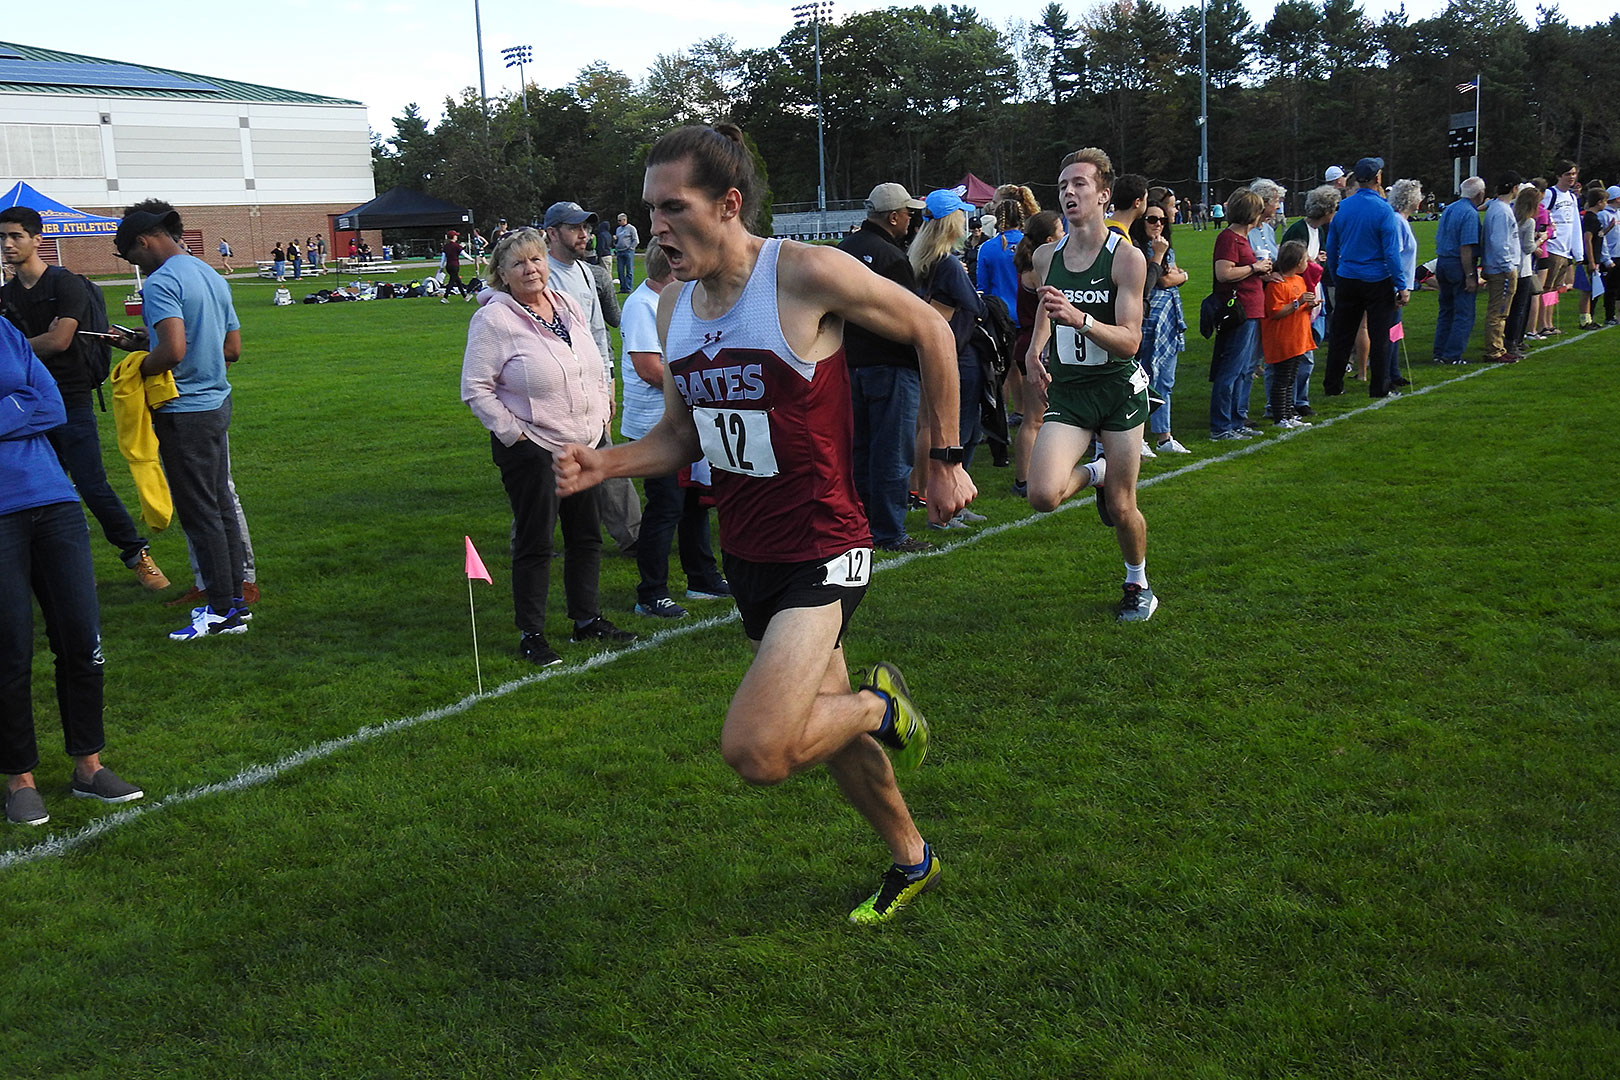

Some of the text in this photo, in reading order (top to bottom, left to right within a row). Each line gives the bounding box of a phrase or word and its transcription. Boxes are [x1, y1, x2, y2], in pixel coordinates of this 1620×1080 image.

[62, 221, 119, 233] ATHLETICS
[1060, 289, 1110, 304] BSON
[1074, 332, 1087, 363] 9
[673, 363, 766, 406] BATES
[714, 412, 755, 471] 12
[844, 550, 864, 582] 12
